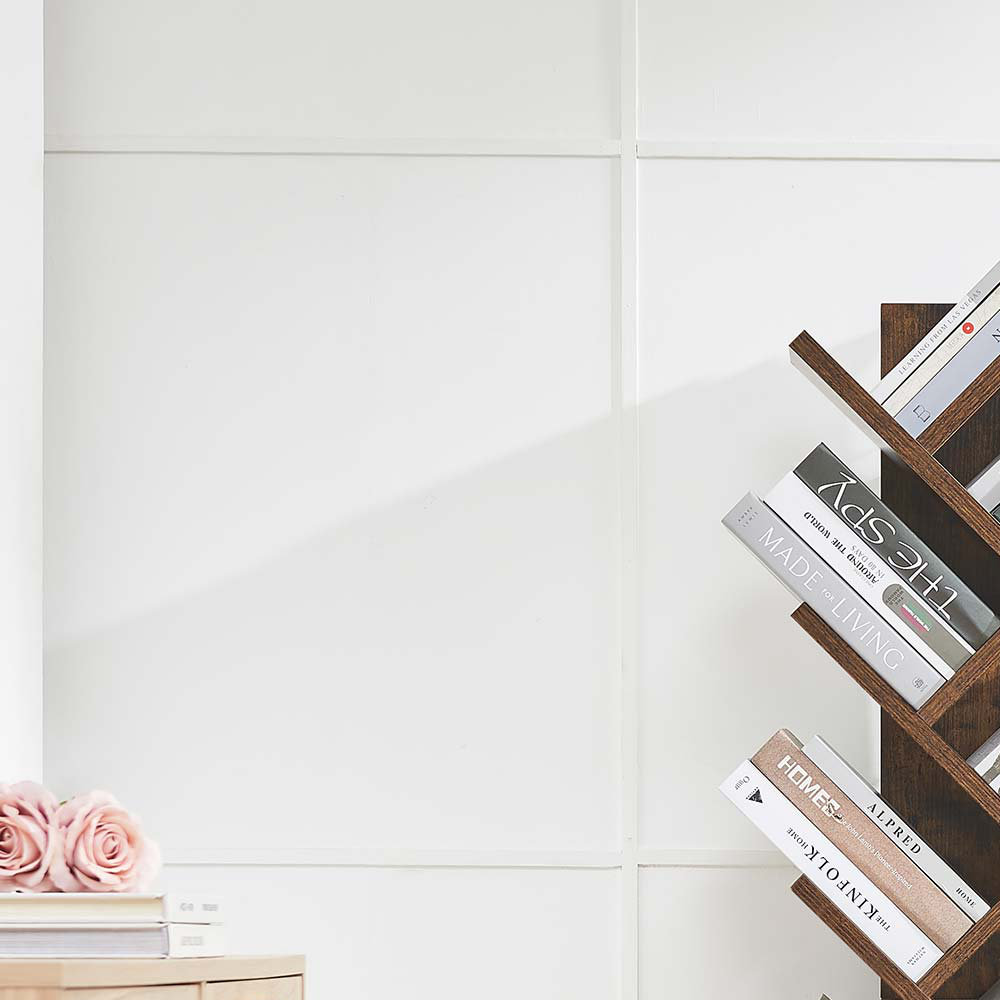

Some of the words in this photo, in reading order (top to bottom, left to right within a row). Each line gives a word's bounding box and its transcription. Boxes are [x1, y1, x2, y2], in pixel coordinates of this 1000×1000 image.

[898, 342, 930, 374] LEARNING
[929, 323, 947, 342] FROM
[947, 310, 960, 324] LAS
[960, 288, 981, 309] VEGAS
[817, 472, 894, 544] SPY
[803, 511, 830, 538] WORLD
[830, 537, 846, 554] THE
[851, 545, 868, 562] DAYS
[846, 553, 879, 583] AROUND
[877, 569, 884, 578] IN
[887, 542, 957, 620] THE
[758, 527, 823, 591] MADE
[831, 597, 904, 670] LIVING
[786, 827, 808, 849] HOME
[867, 803, 920, 853] ALPRED
[955, 887, 976, 907] HOME
[804, 845, 878, 919] KINFOLK
[875, 915, 890, 931] THE
